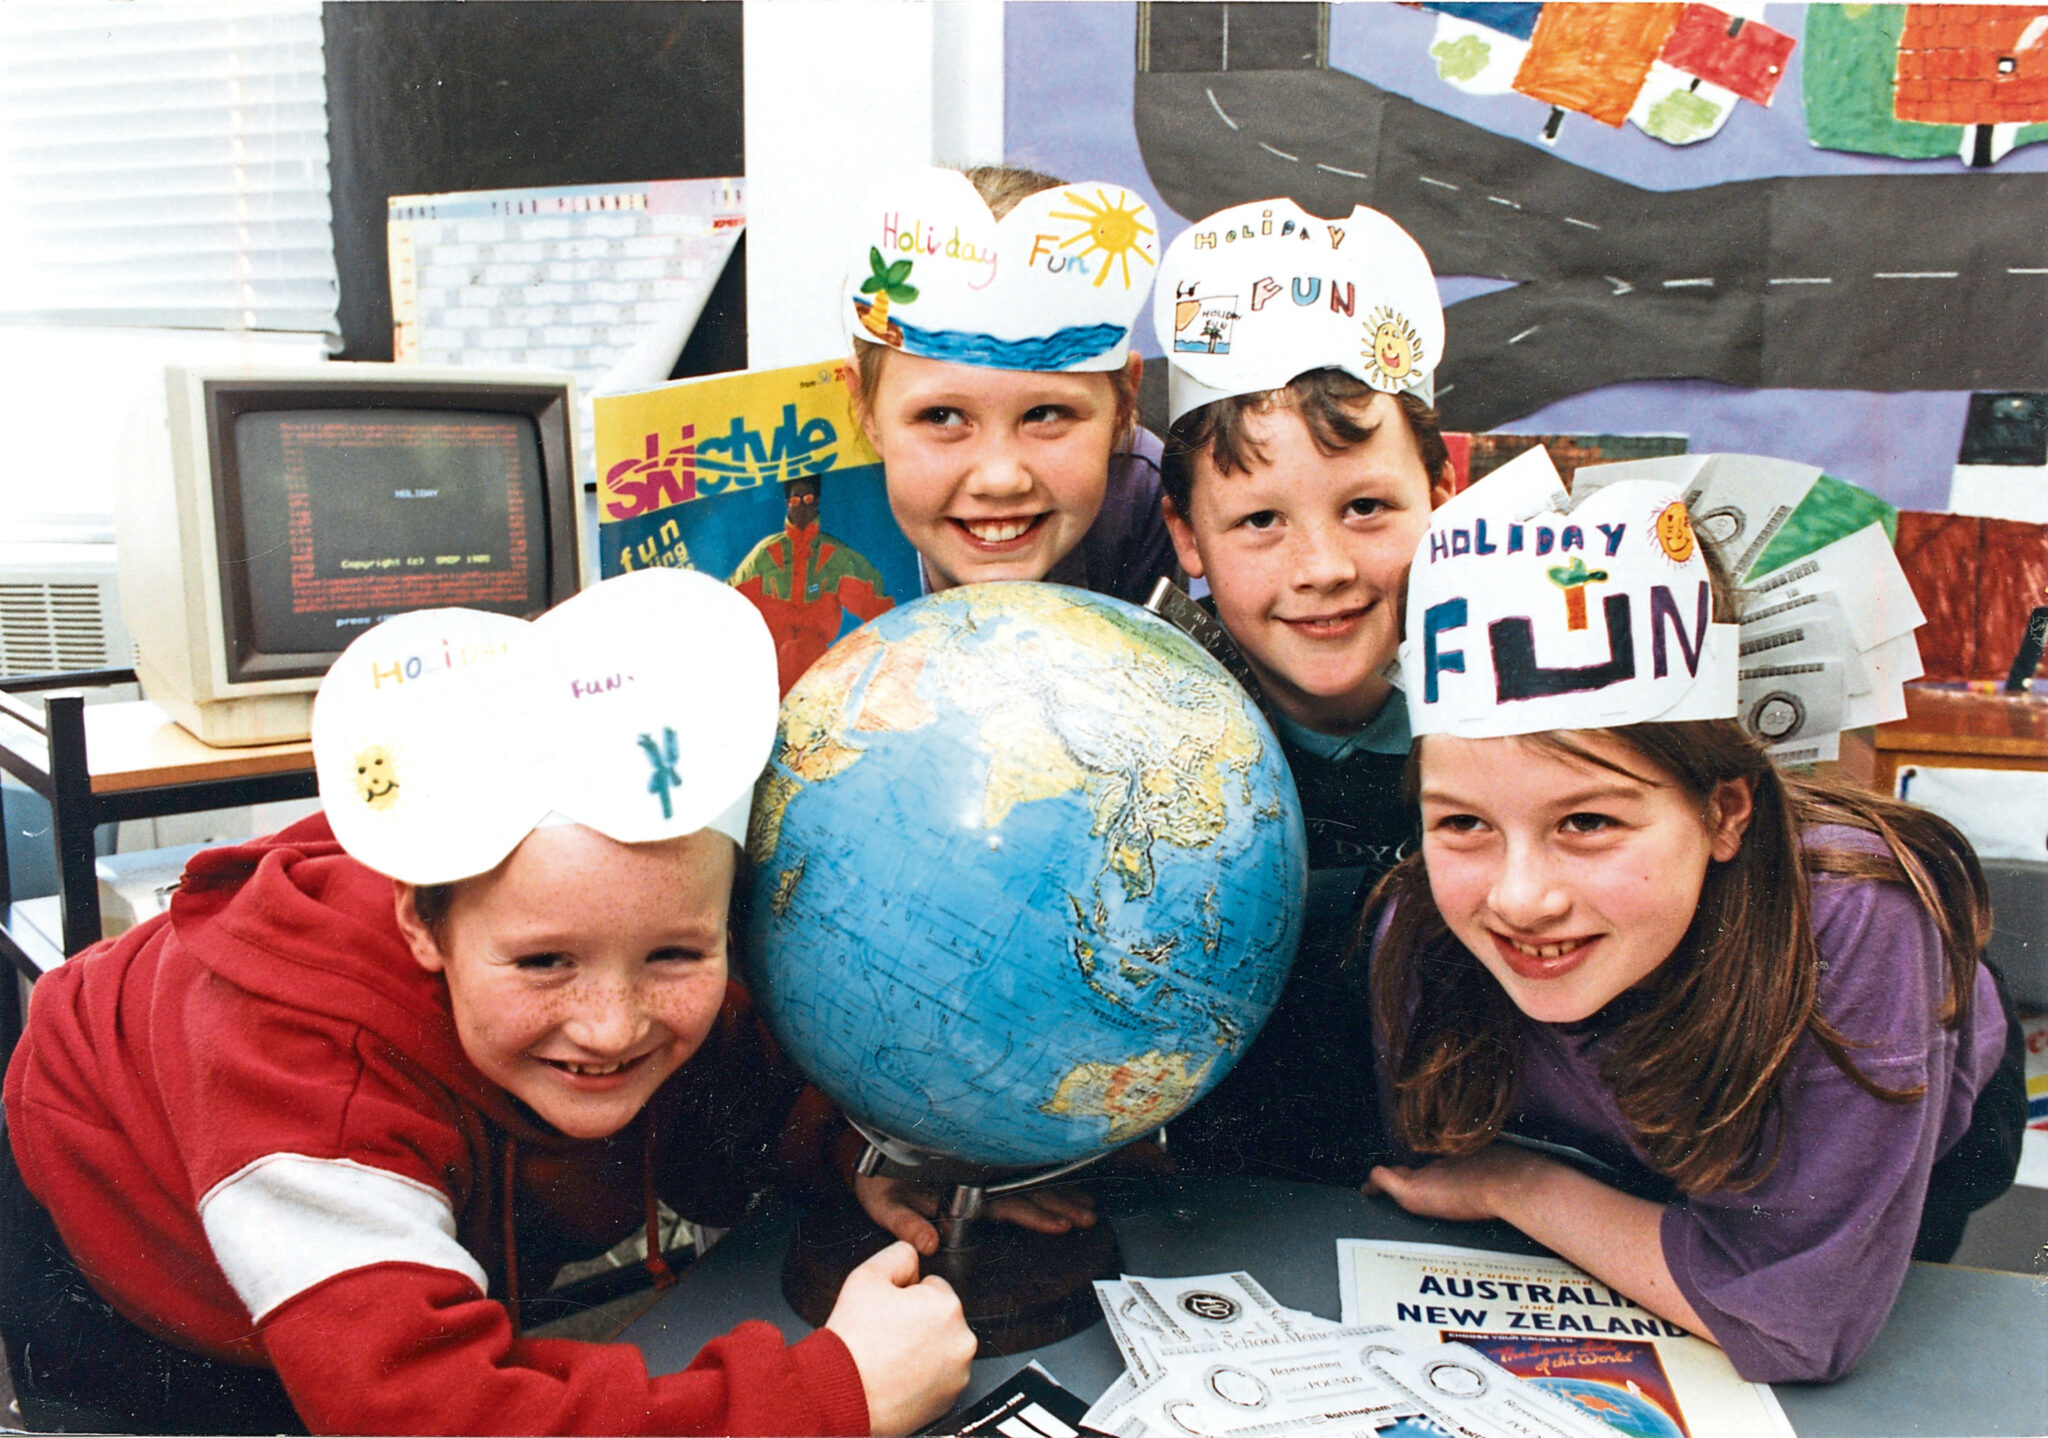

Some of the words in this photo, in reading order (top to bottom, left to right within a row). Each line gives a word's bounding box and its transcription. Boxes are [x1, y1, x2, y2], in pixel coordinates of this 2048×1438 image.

[883, 211, 998, 291] Holiday
[1028, 234, 1090, 275] Fun
[1251, 276, 1356, 318] FUN
[619, 518, 680, 574] fun
[1430, 515, 1627, 564] HOLIDAY
[340, 558, 400, 570] Copyright
[1423, 580, 1710, 706] FUN
[1419, 1275, 1638, 1310] AUSTRALI
[1519, 1303, 1556, 1312] and
[1396, 1302, 1488, 1328] NEW
[1505, 1311, 1692, 1338] ZEALAND
[1448, 1332, 1489, 1341] CHOOSE
[1491, 1334, 1518, 1342] YOUR
[1535, 1357, 1552, 1376] of
[1552, 1355, 1577, 1369] the
[1323, 1403, 1392, 1421] Nottingham
